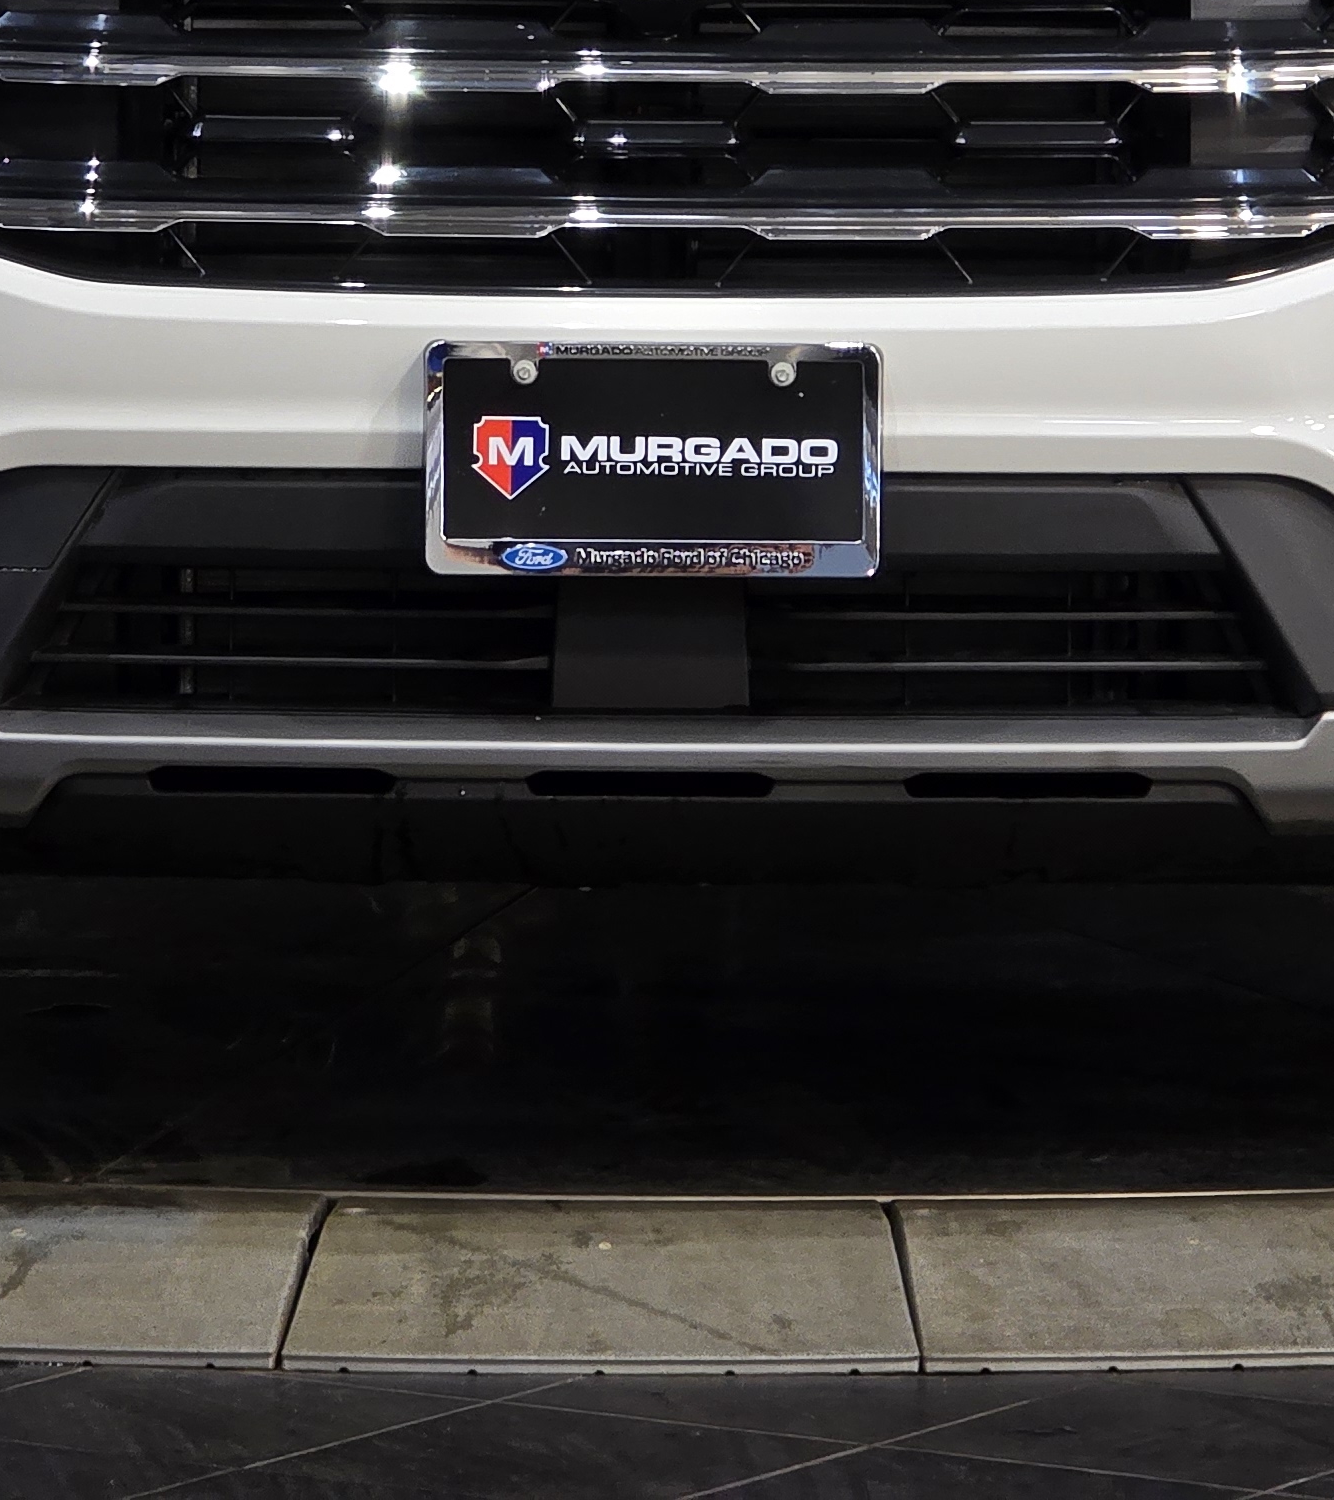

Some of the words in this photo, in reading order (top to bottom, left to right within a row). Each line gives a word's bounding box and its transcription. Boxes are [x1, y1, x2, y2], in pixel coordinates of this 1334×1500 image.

[555, 344, 634, 356] MURGADO
[634, 346, 719, 357] AUTOMOTIVE
[721, 346, 770, 357] GROUP
[488, 437, 535, 467] M
[560, 435, 839, 465] MURGADO
[563, 461, 734, 477] AUTOMOTIVE
[740, 464, 836, 479] GROUP
[514, 548, 555, 566] Ford
[576, 547, 658, 567] Murgado
[660, 548, 705, 565] Ford
[708, 548, 728, 566] of
[730, 548, 805, 568] Chicago
